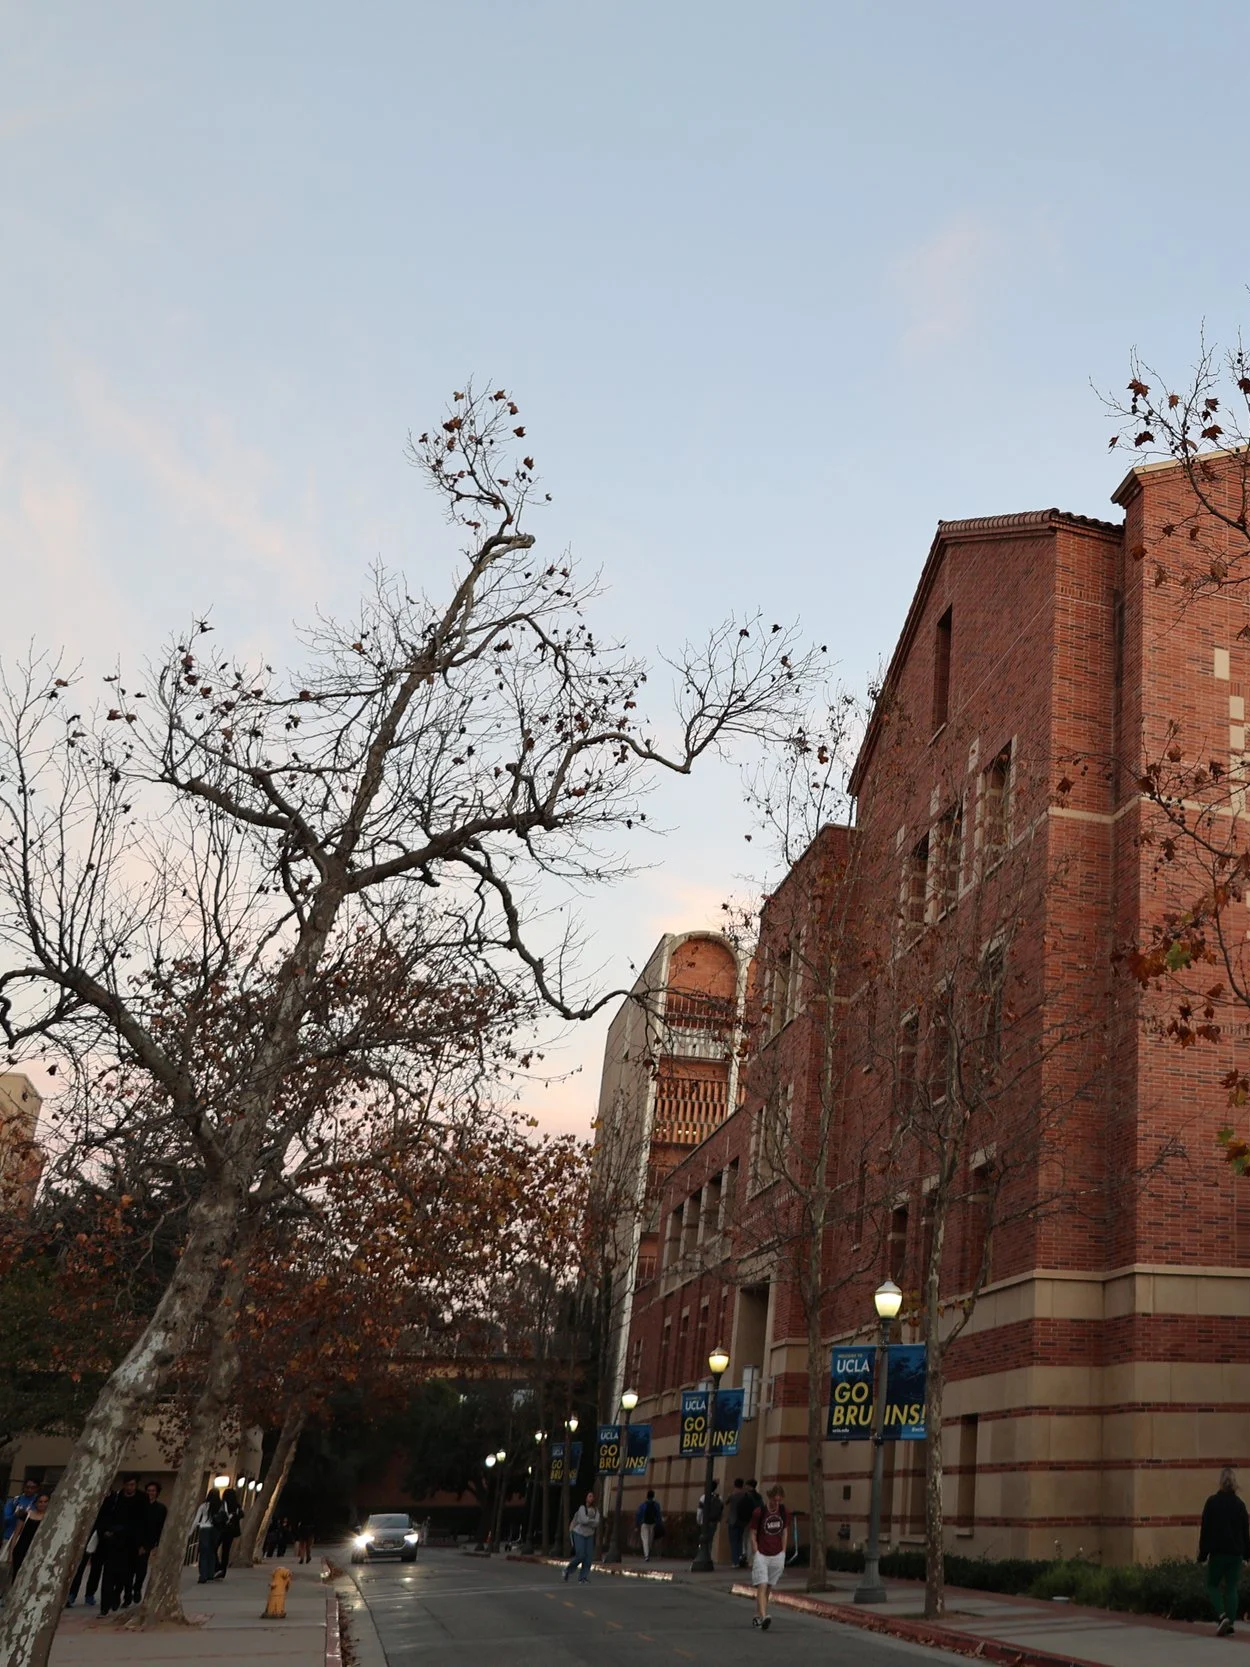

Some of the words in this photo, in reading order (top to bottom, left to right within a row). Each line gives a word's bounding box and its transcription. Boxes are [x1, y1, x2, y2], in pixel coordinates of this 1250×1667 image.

[836, 1359, 870, 1373] UCLA
[834, 1382, 869, 1403] GO
[685, 1400, 706, 1411] UCLA
[832, 1405, 874, 1426] BRU
[884, 1403, 926, 1425] INS!
[684, 1416, 706, 1432] GO
[600, 1431, 619, 1440] UCLA
[682, 1432, 708, 1448] BRU
[712, 1430, 738, 1446] INS!
[599, 1444, 618, 1457] GO
[551, 1459, 563, 1470] GO
[599, 1457, 620, 1469] BRU
[625, 1455, 648, 1469] INS!
